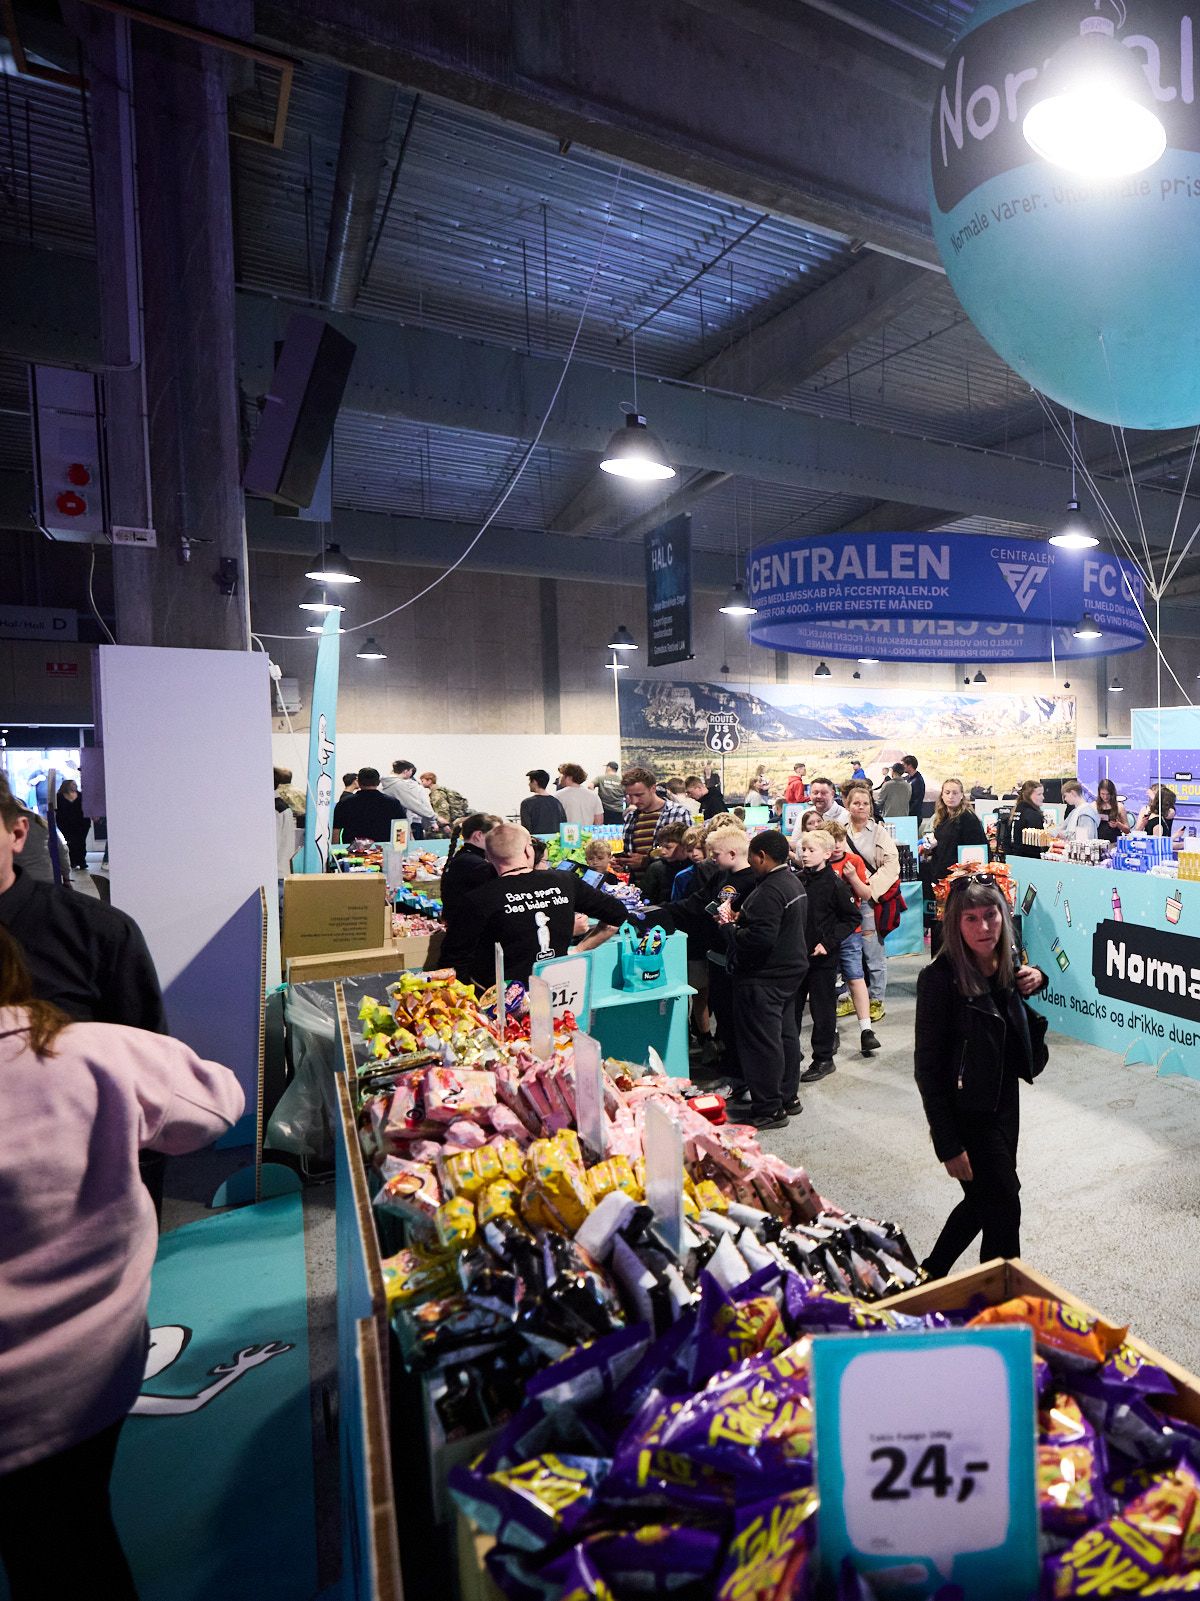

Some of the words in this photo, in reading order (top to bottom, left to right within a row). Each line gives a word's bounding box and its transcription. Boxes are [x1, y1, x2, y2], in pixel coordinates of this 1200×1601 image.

[940, 15, 1194, 167] Noral
[951, 211, 990, 255] Normale
[991, 192, 1049, 223] varer.
[651, 545, 667, 572] HAL
[990, 548, 1055, 564] CENTRALEN
[752, 544, 950, 593] CENTRALEN
[1083, 559, 1117, 598] FC
[768, 588, 826, 605] MEDLEMSSKAB
[829, 583, 843, 597] PÅ
[844, 585, 950, 597] FCCENTRALEN.DK
[772, 606, 786, 616] FOR
[786, 603, 815, 615] 4000.-
[816, 601, 842, 612] HVER
[845, 599, 887, 611] ENESTE
[888, 596, 933, 610] MÅNED
[1083, 598, 1115, 612] TILMELD
[53, 618, 67, 630] D
[1094, 613, 1106, 623] OG
[1106, 615, 1122, 626] VIND
[710, 715, 734, 723] ROUTE
[715, 725, 730, 733] US
[711, 733, 734, 751] 66
[504, 903, 525, 914] Jeg
[525, 899, 551, 911] bider
[551, 895, 569, 906] ikke
[505, 892, 533, 902] Bare
[1070, 995, 1107, 1019] snacks
[1110, 1010, 1124, 1027] og
[1128, 1011, 1165, 1038] drikke
[1169, 1023, 1200, 1047] duer
[870, 1443, 990, 1503] 24,-
